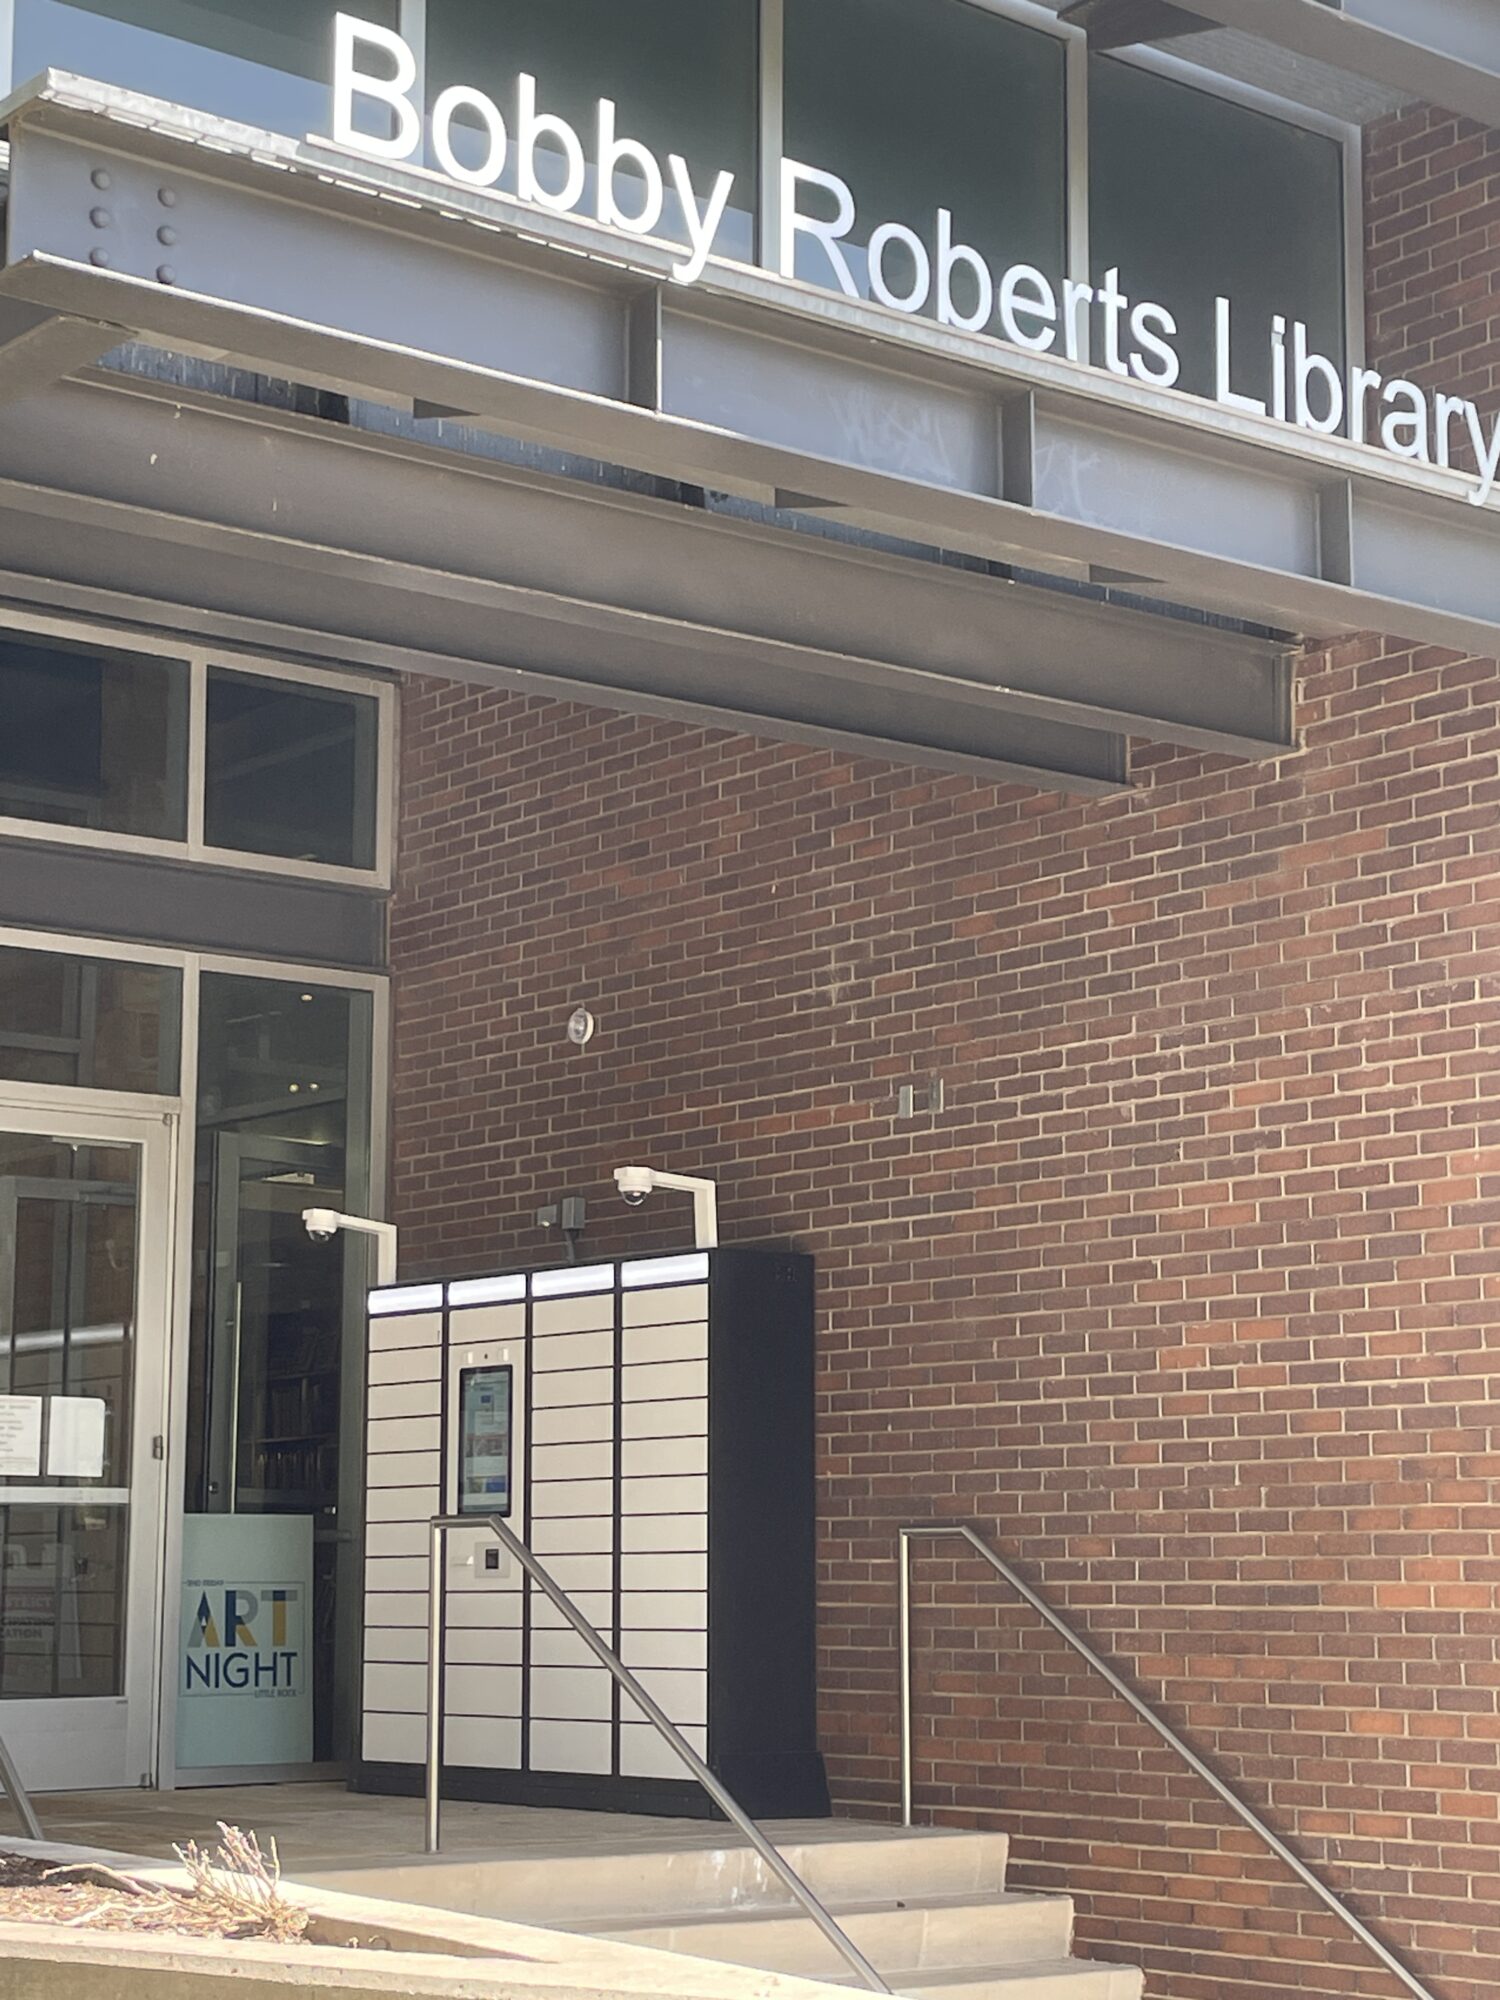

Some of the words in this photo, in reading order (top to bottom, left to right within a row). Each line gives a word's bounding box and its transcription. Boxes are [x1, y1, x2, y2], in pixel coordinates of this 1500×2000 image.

[333, 11, 735, 284] Bobby
[779, 156, 1181, 389] Roberts
[1215, 296, 1500, 507] Library
[187, 1590, 299, 1648] ART
[186, 1651, 298, 1689] NIGHT
